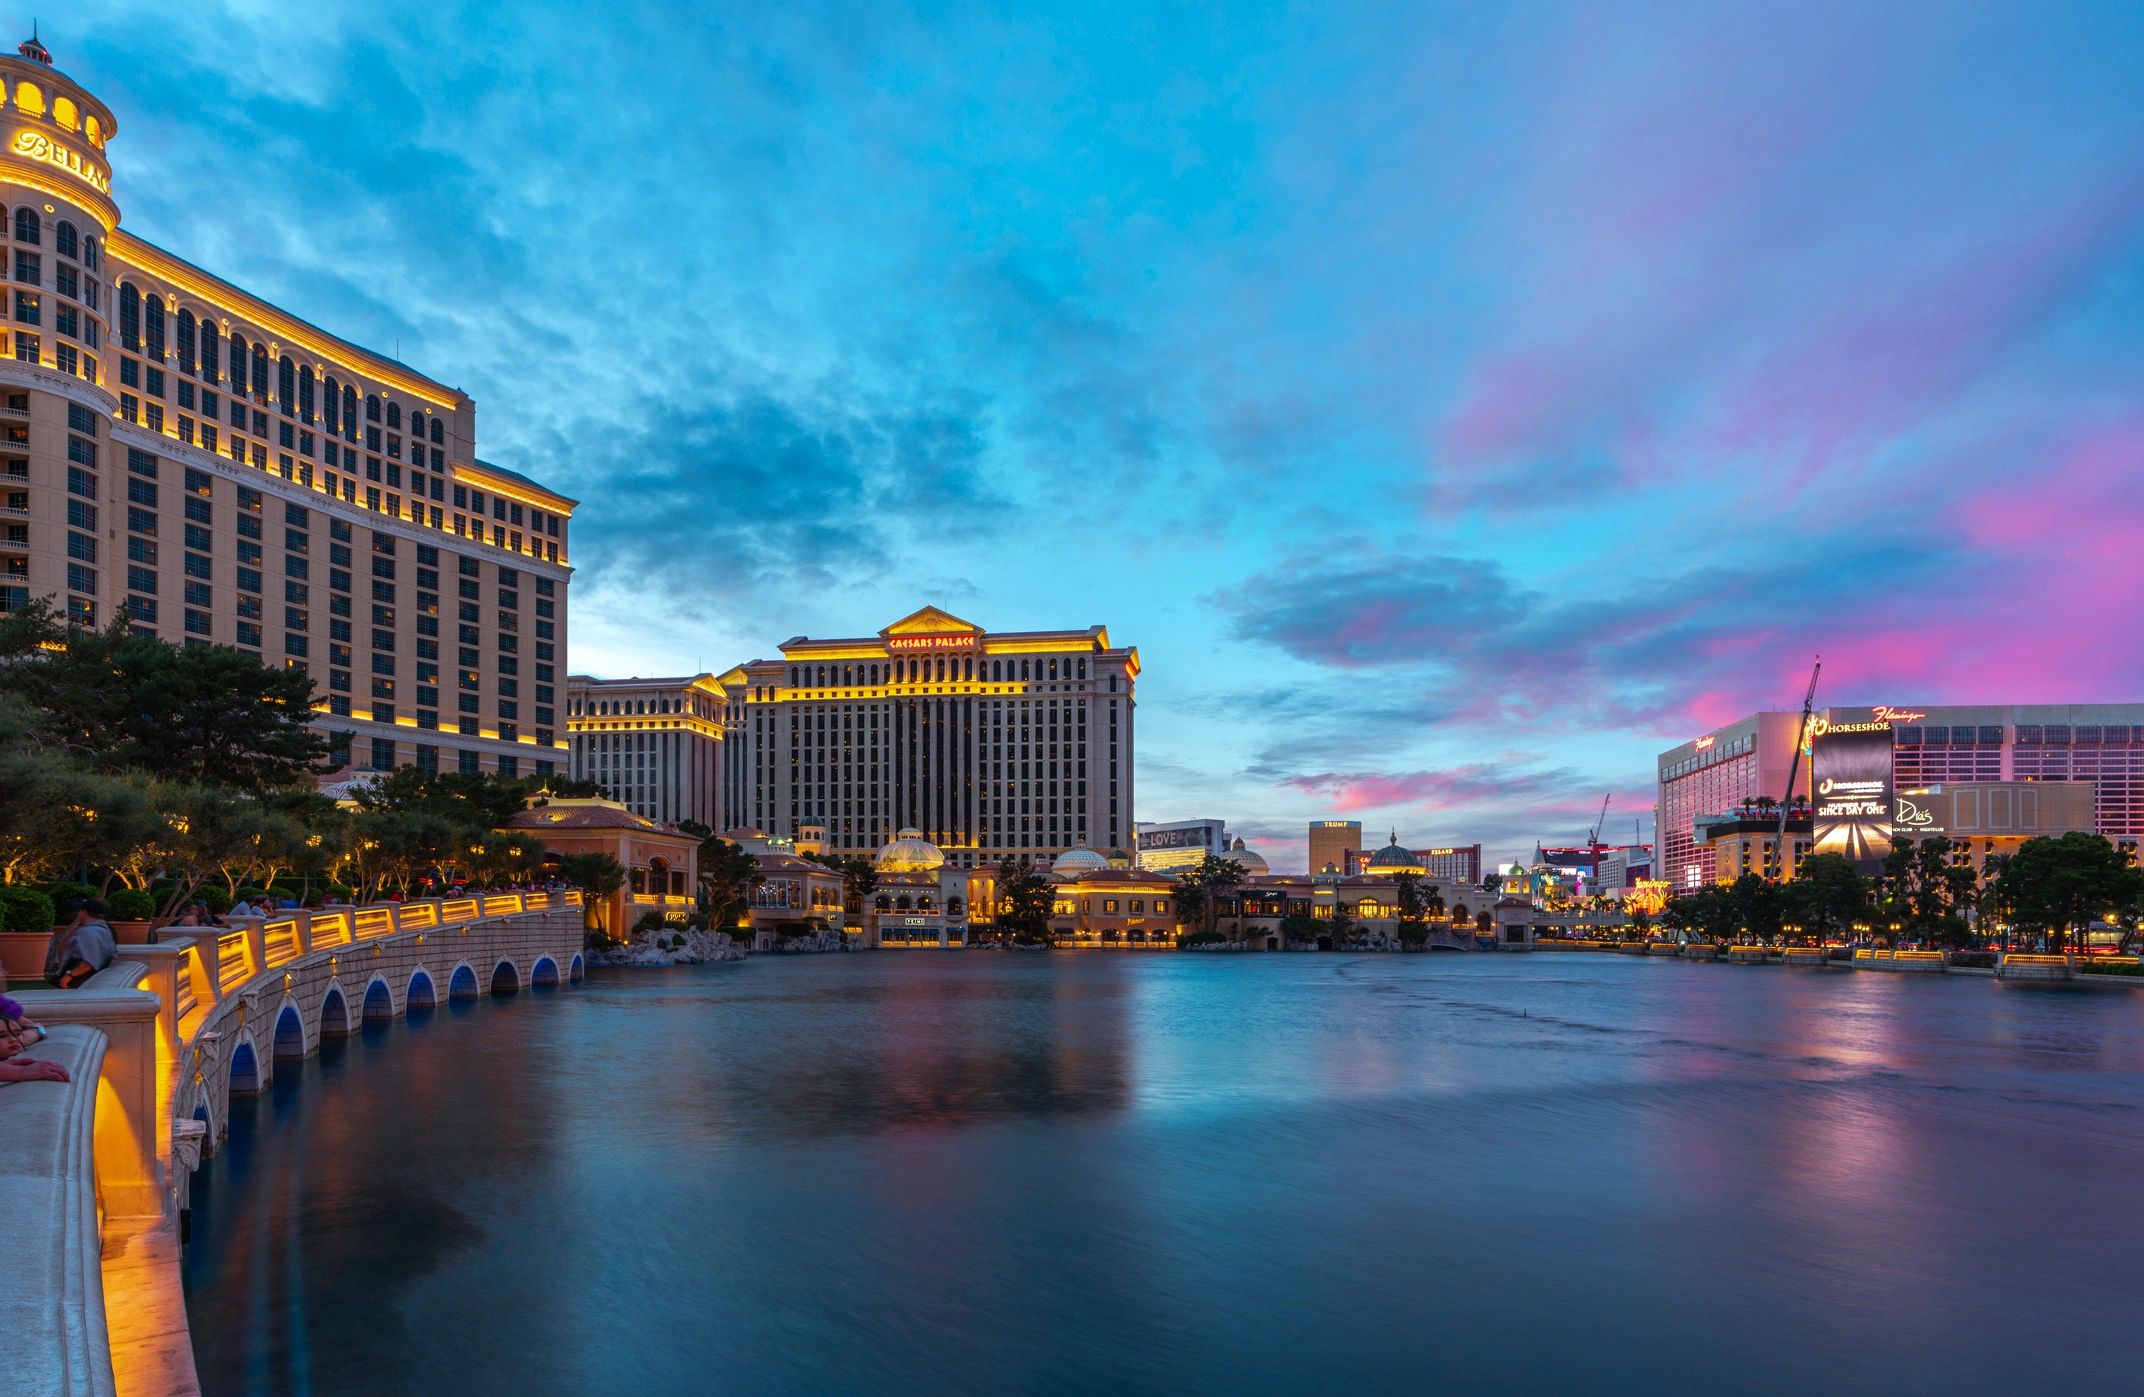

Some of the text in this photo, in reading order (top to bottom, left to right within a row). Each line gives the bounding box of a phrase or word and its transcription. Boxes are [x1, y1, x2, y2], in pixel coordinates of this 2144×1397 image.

[889, 637, 974, 648] CAESARS PALACE
[1872, 706, 1926, 723] Flamingo
[1828, 722, 1890, 733] HORSESHOE
[1818, 803, 1885, 816] SINCE DAY ONE
[1151, 832, 1177, 847] LOVE
